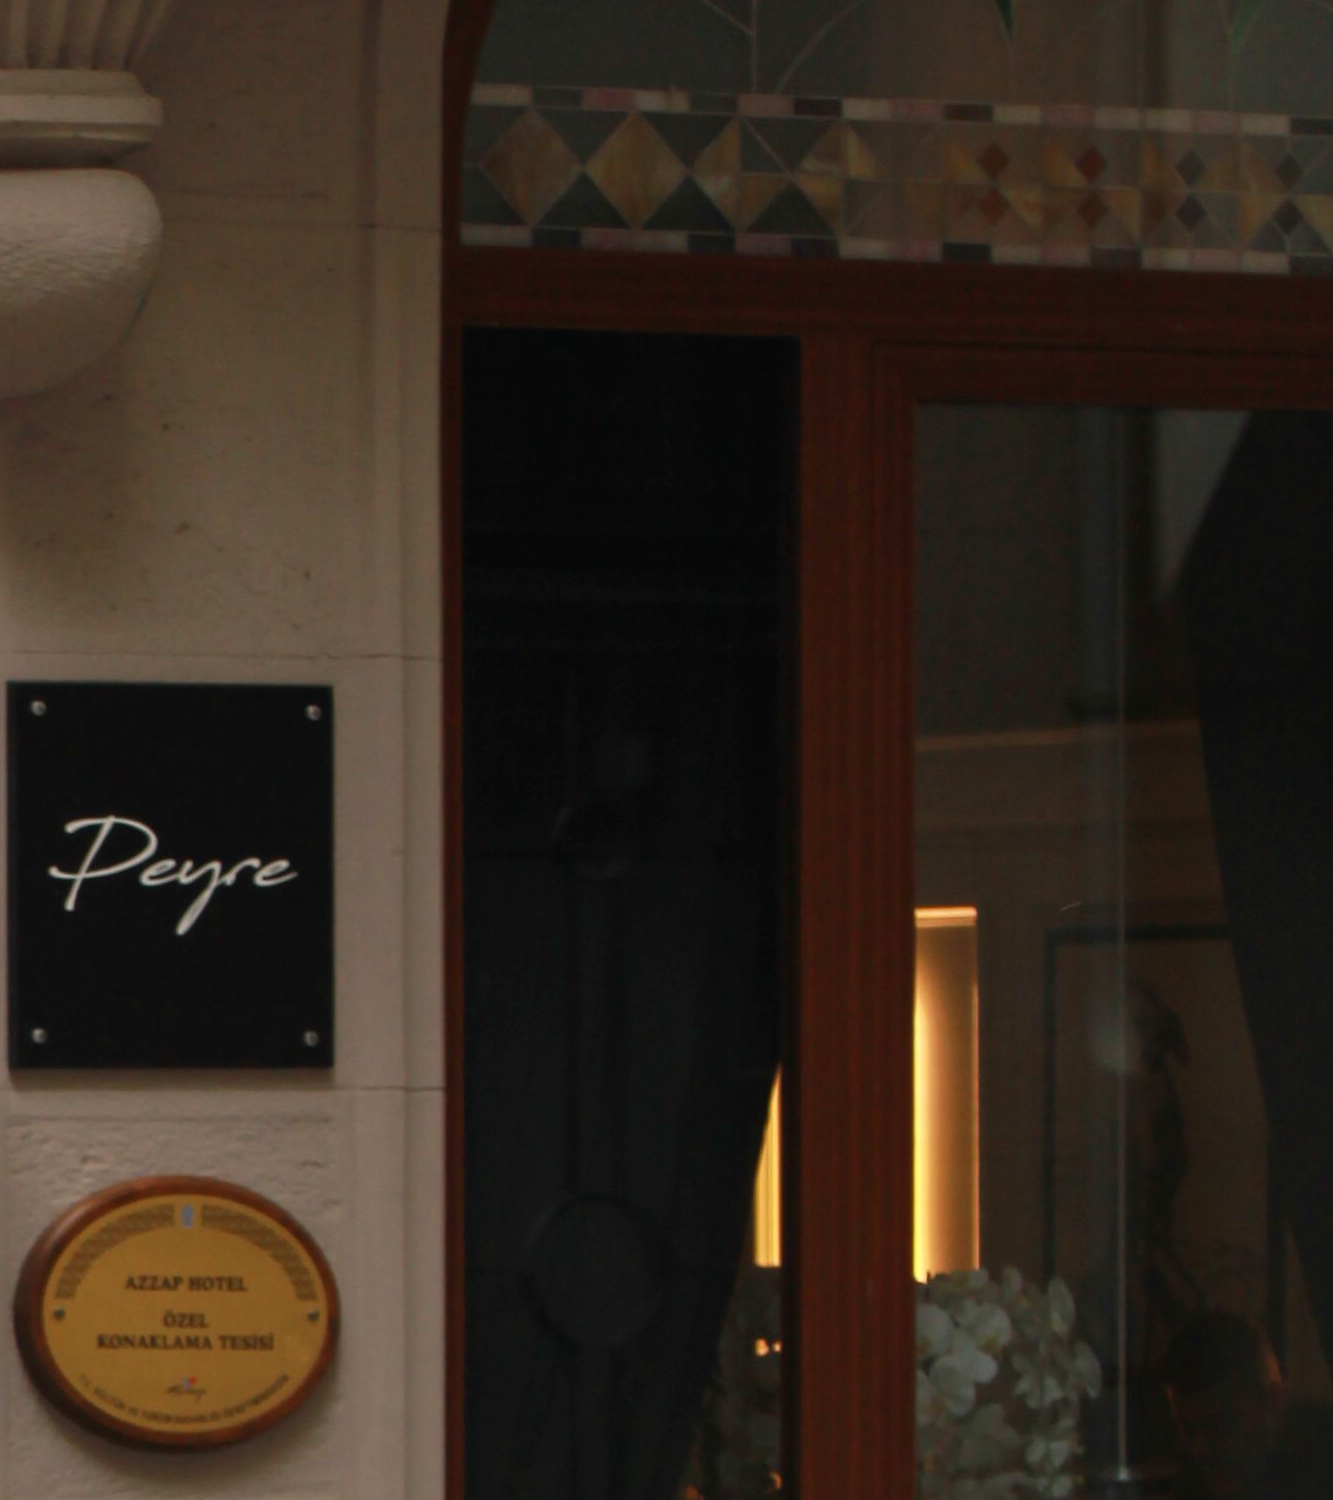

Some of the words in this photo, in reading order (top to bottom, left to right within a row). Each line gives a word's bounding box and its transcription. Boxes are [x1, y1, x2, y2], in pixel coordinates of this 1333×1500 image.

[47, 815, 298, 935] Peyre
[124, 1276, 183, 1292] AZZAP
[188, 1276, 248, 1292] HOTEL
[162, 1309, 209, 1329] ÖZEL
[97, 1333, 212, 1351] KONAKLAMA
